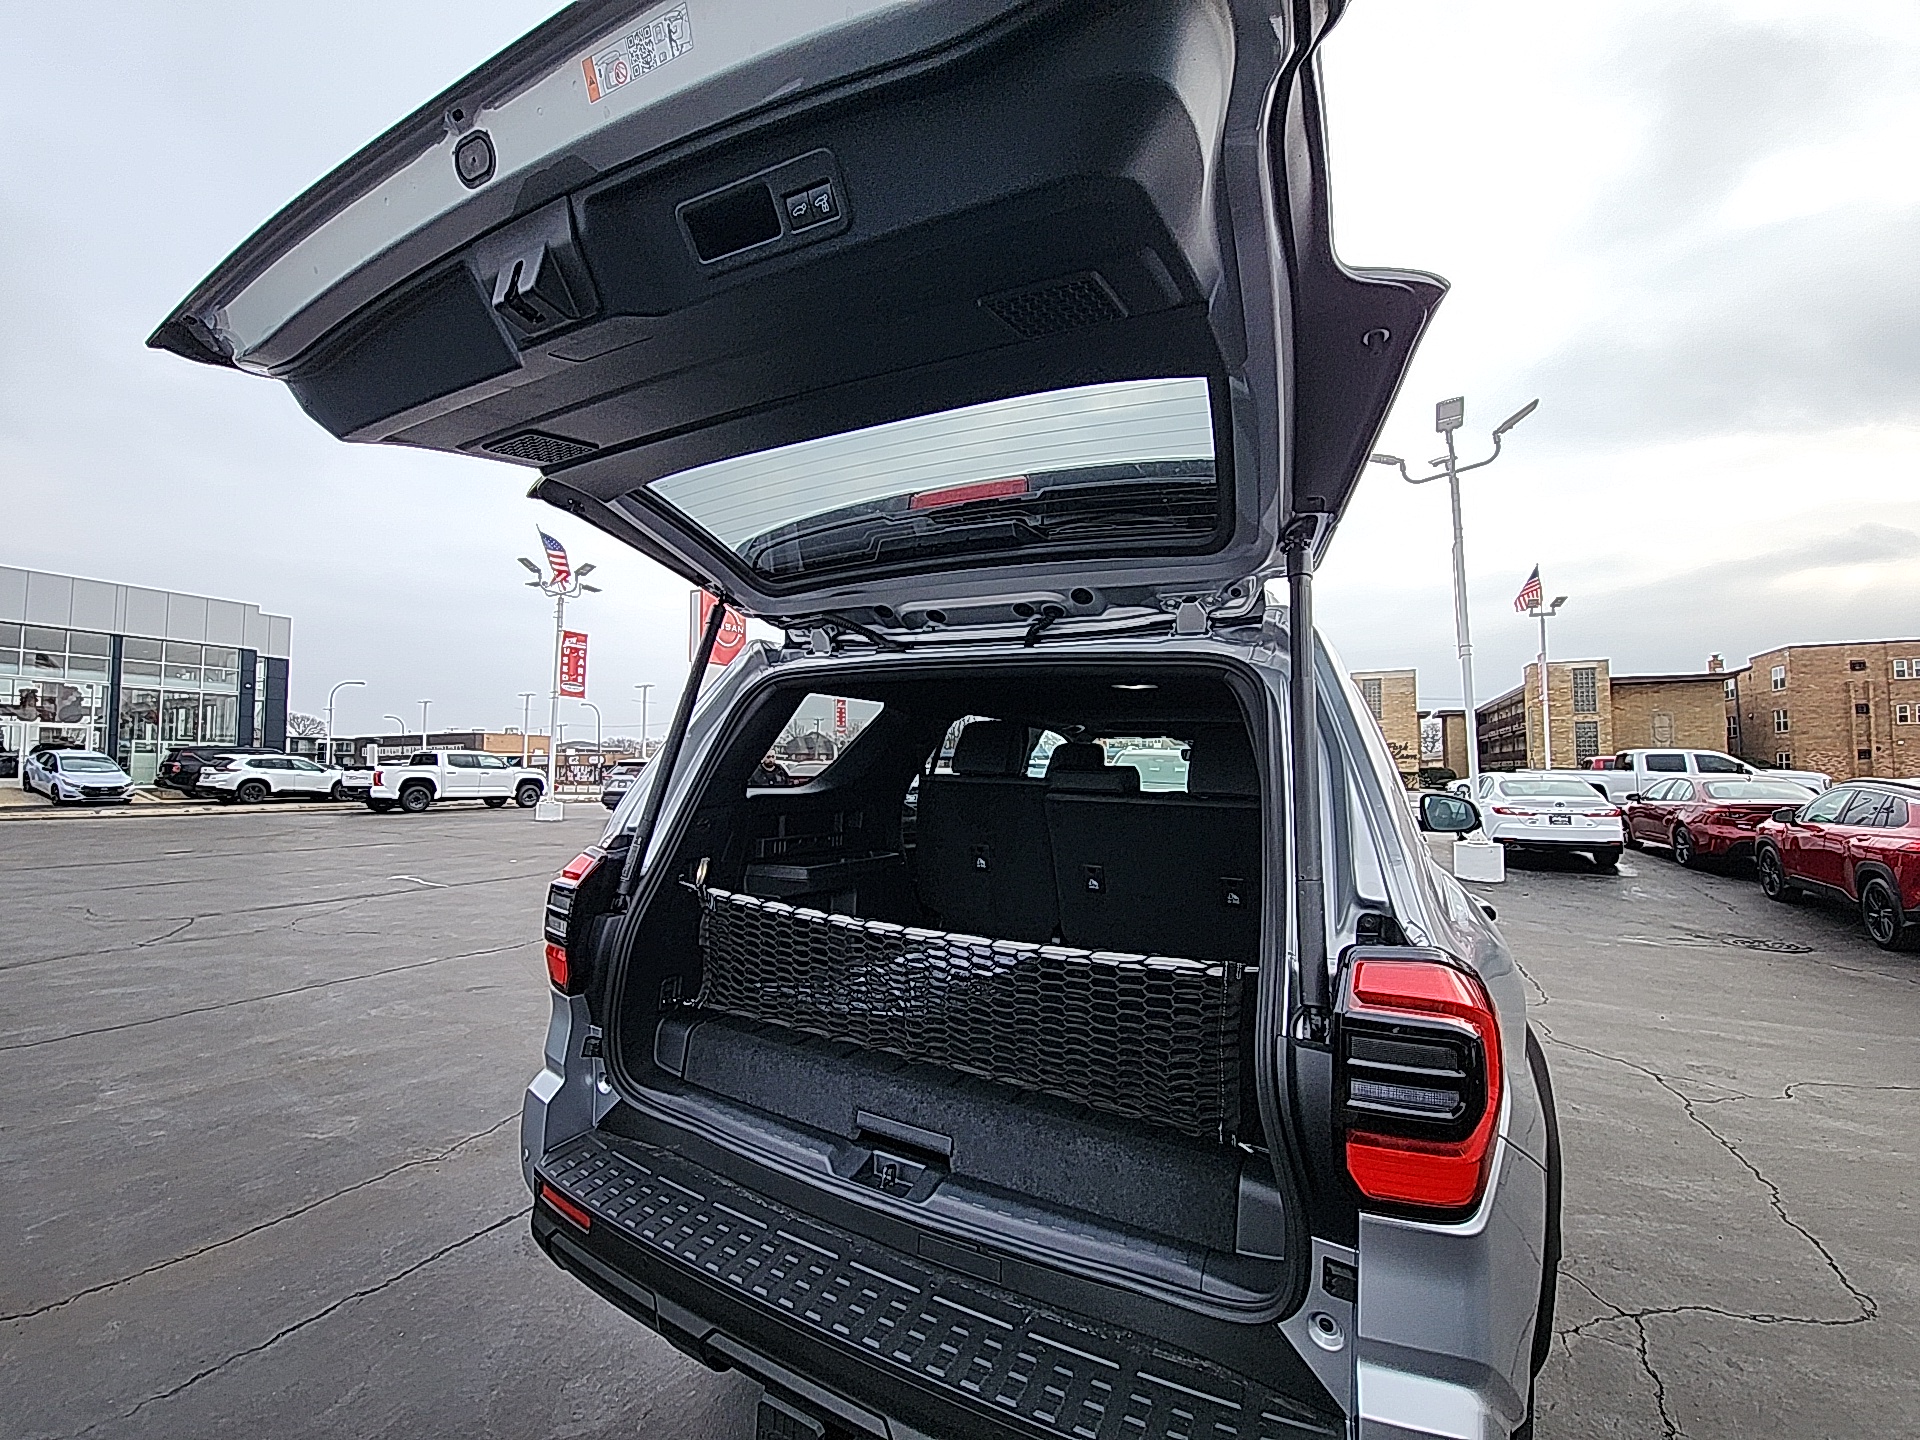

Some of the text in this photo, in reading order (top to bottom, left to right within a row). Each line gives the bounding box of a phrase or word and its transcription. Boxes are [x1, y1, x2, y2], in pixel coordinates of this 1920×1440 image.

[722, 623, 744, 634] SAN
[562, 647, 570, 681] USED
[577, 650, 585, 683] CARS
